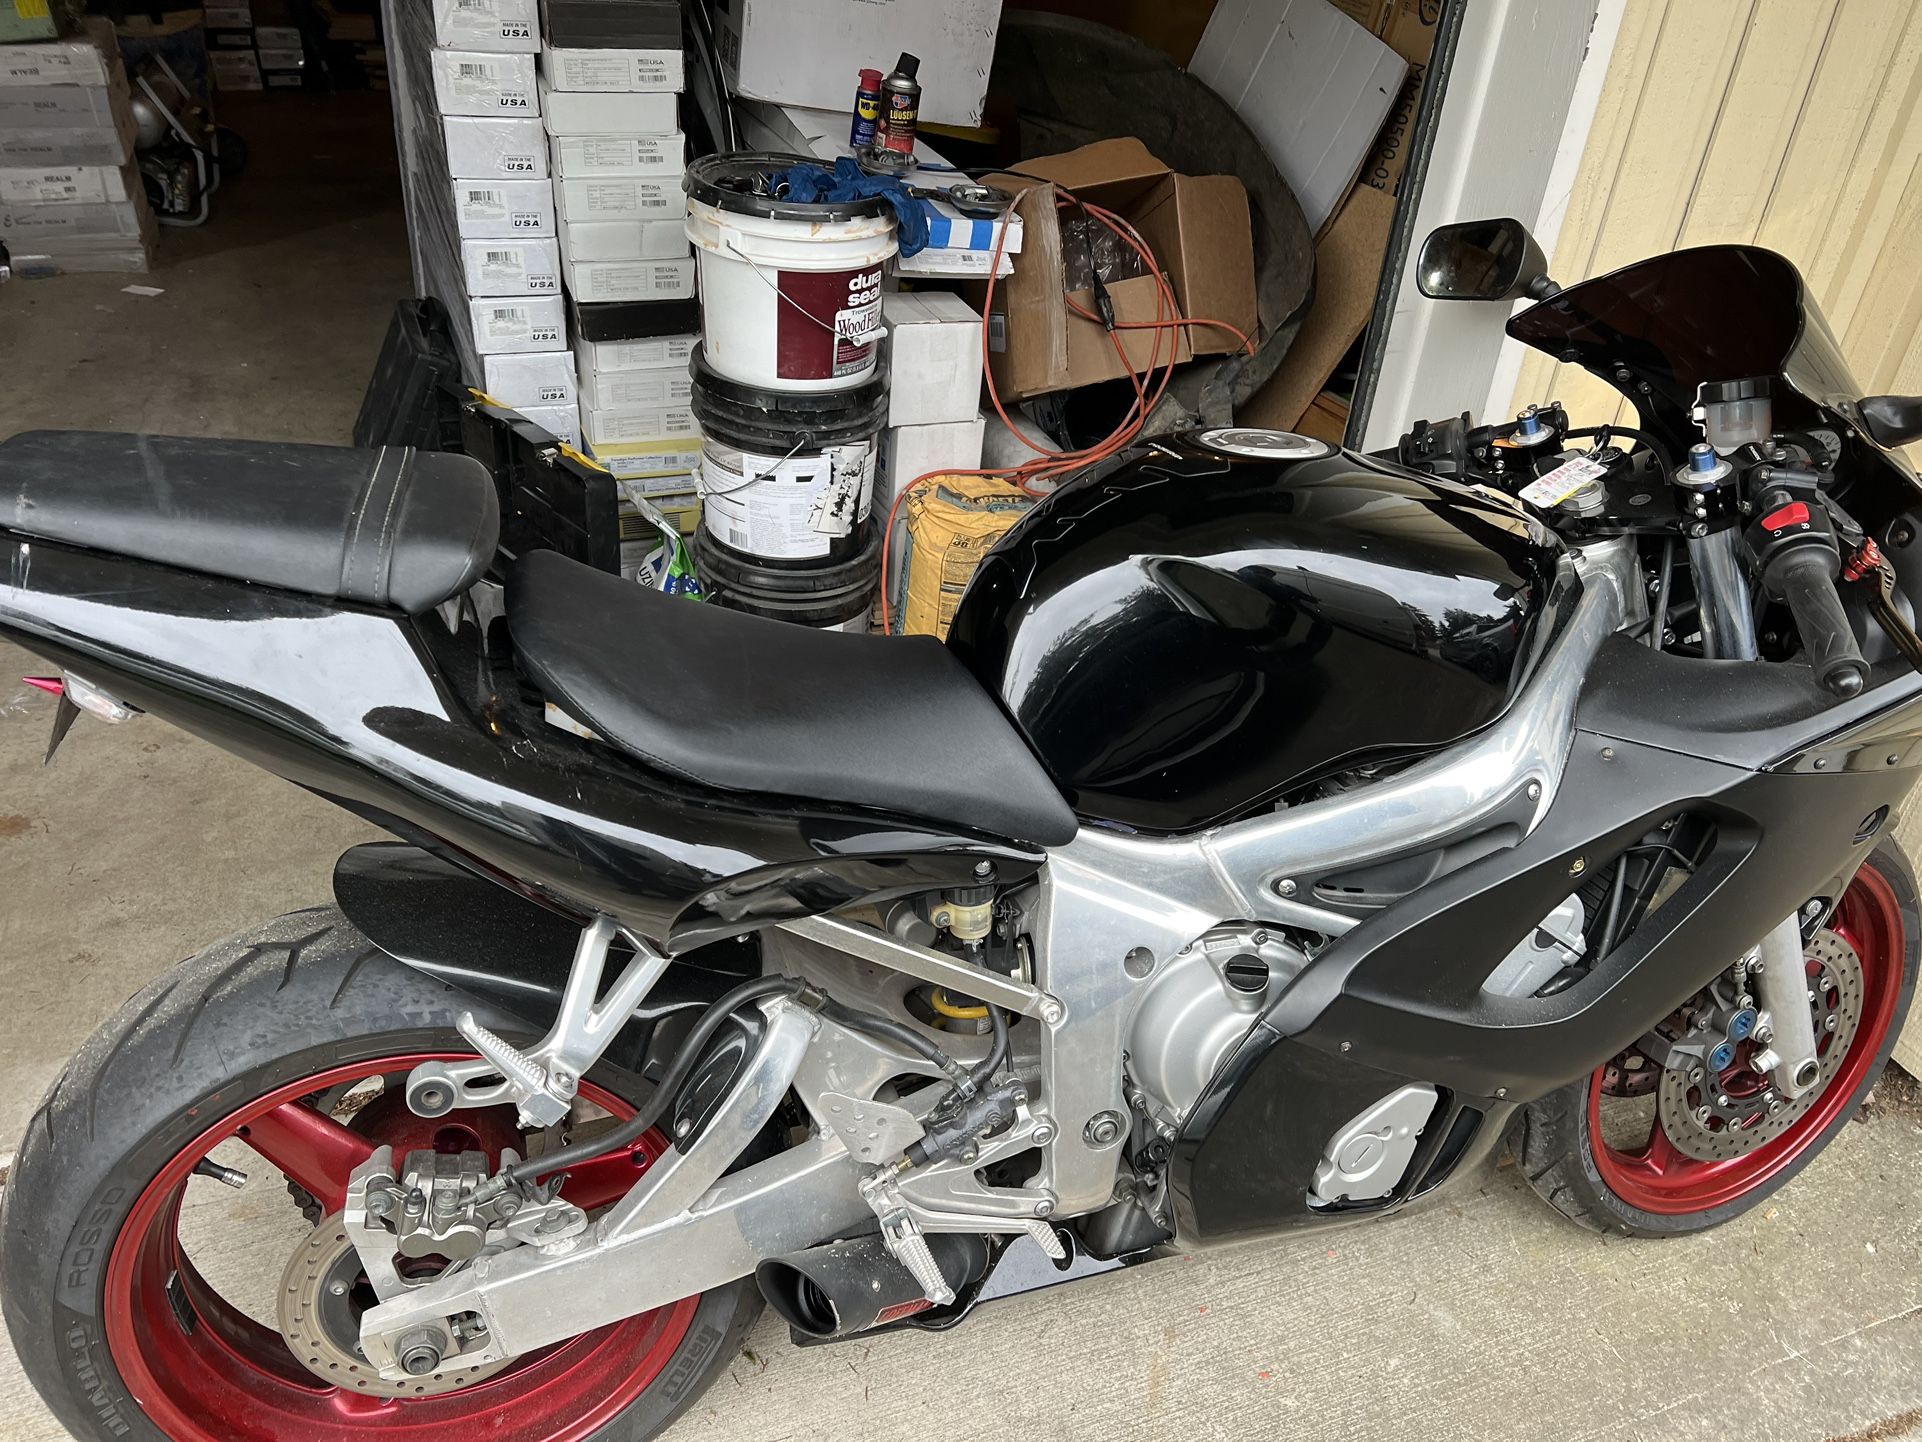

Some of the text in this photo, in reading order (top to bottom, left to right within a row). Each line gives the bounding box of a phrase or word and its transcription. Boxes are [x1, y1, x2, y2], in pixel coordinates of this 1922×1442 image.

[502, 29, 530, 38] USA
[500, 98, 527, 107] USA
[507, 163, 533, 171] USA
[514, 219, 540, 227] USA
[530, 281, 555, 289] USA
[848, 270, 882, 291] dura
[847, 281, 881, 307] seal
[837, 314, 867, 337] Wood
[532, 333, 557, 341] USA
[68, 1186, 127, 1289] ROSSO
